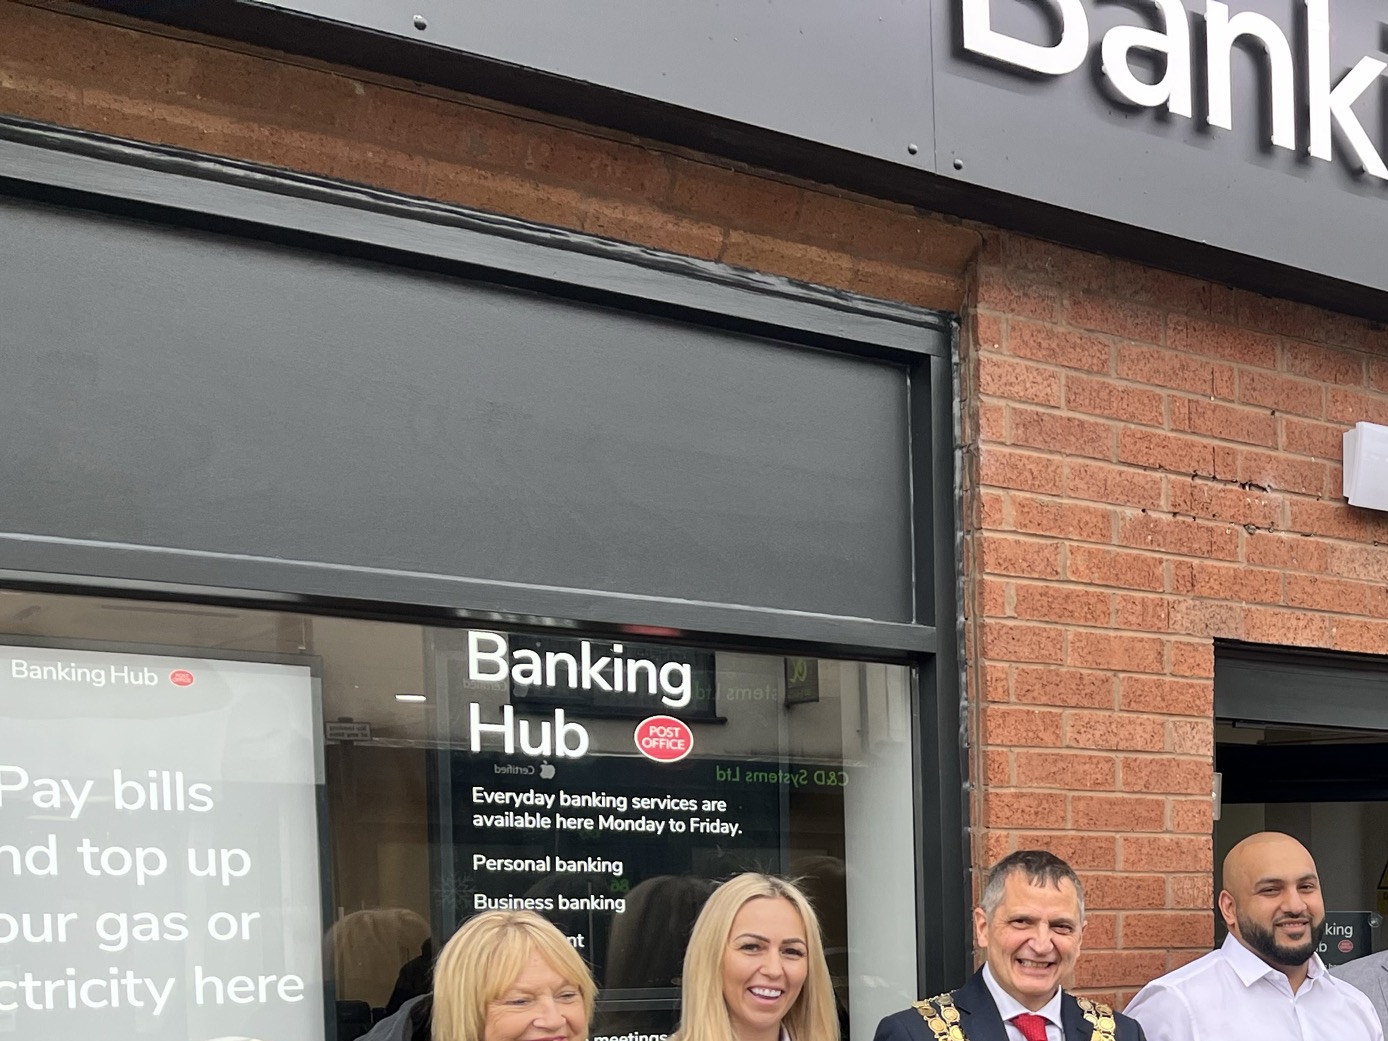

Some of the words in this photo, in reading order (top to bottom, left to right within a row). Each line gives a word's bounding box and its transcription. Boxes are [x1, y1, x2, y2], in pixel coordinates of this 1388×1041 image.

[11, 659, 106, 687] Banking
[110, 665, 159, 687] Hub
[466, 630, 692, 707] Banking
[468, 701, 590, 759] Hub
[641, 737, 686, 750] OFFICE
[649, 725, 681, 738] POST
[0, 764, 94, 819] Pay
[113, 769, 214, 812] bills
[472, 786, 556, 809] Everyday
[559, 789, 628, 812] banking
[631, 795, 698, 811] services
[701, 799, 727, 812] are
[472, 811, 552, 830] available
[555, 814, 594, 831] here
[598, 815, 665, 835] Monday
[668, 818, 686, 832] to
[689, 817, 743, 837] Friday.
[0, 834, 58, 876] nd
[76, 838, 168, 886] top
[187, 847, 252, 886] up
[473, 854, 551, 872] Personal
[555, 856, 624, 876] banking
[474, 893, 554, 910] Business
[558, 895, 626, 913] banking
[0, 912, 78, 944] our
[96, 911, 189, 952] gas
[207, 911, 261, 941] or
[1325, 922, 1354, 938] king
[0, 967, 176, 1016] ctricity
[194, 965, 305, 1005] here
